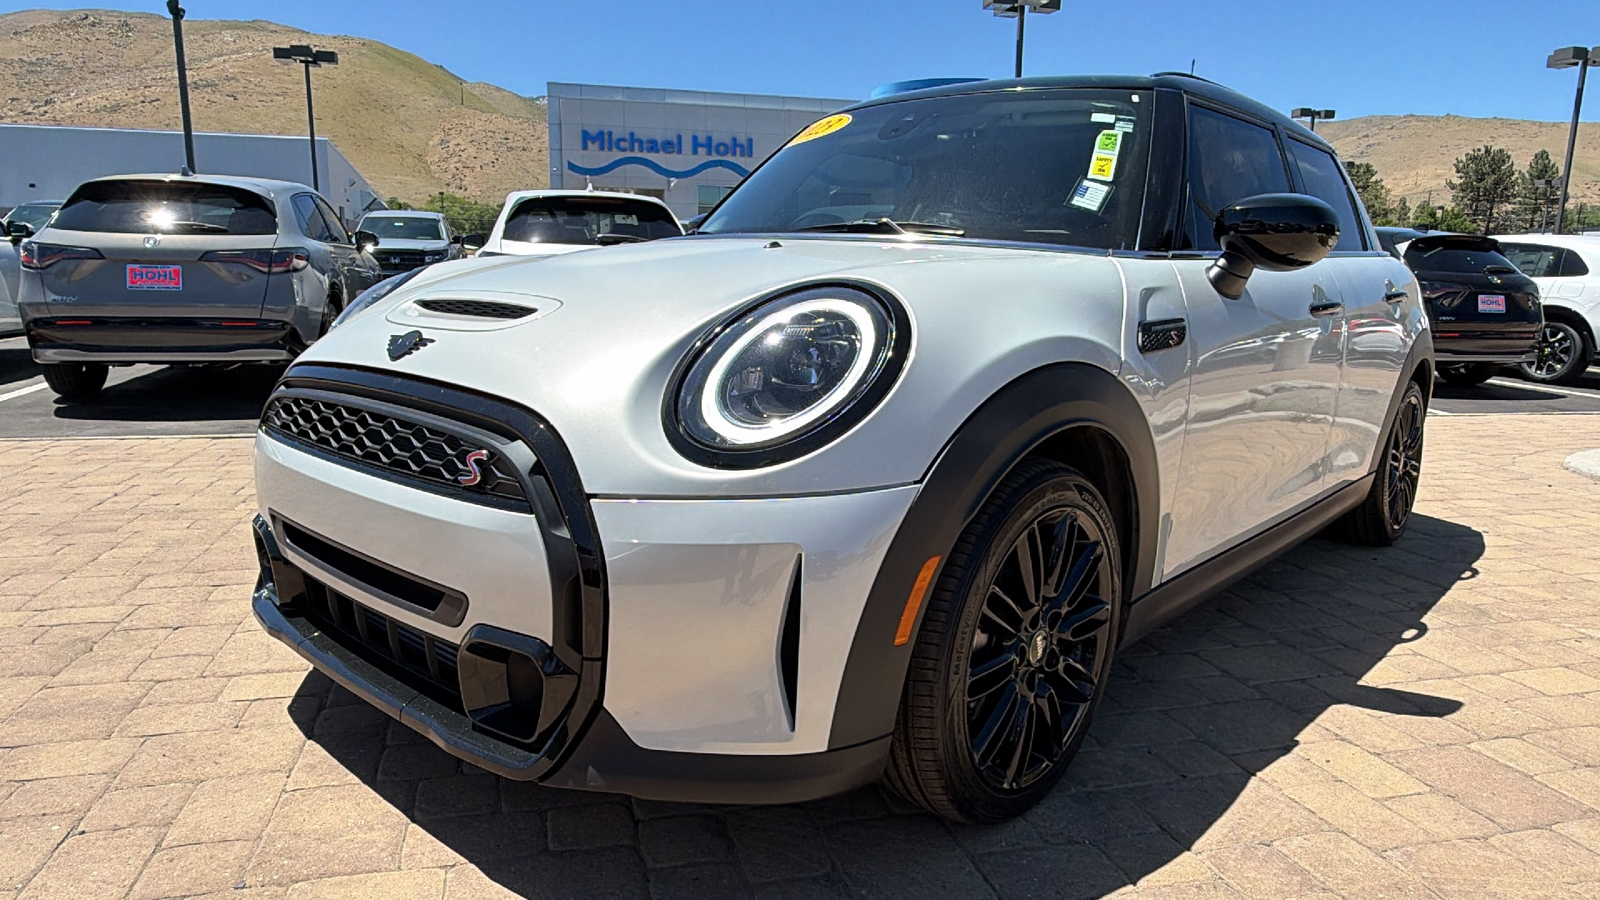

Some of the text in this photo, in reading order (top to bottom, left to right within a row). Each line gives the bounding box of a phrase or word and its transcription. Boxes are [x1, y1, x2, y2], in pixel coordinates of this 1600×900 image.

[581, 129, 754, 158] Michael Hohl
[132, 270, 177, 281] HOHL
[457, 450, 489, 486] S
